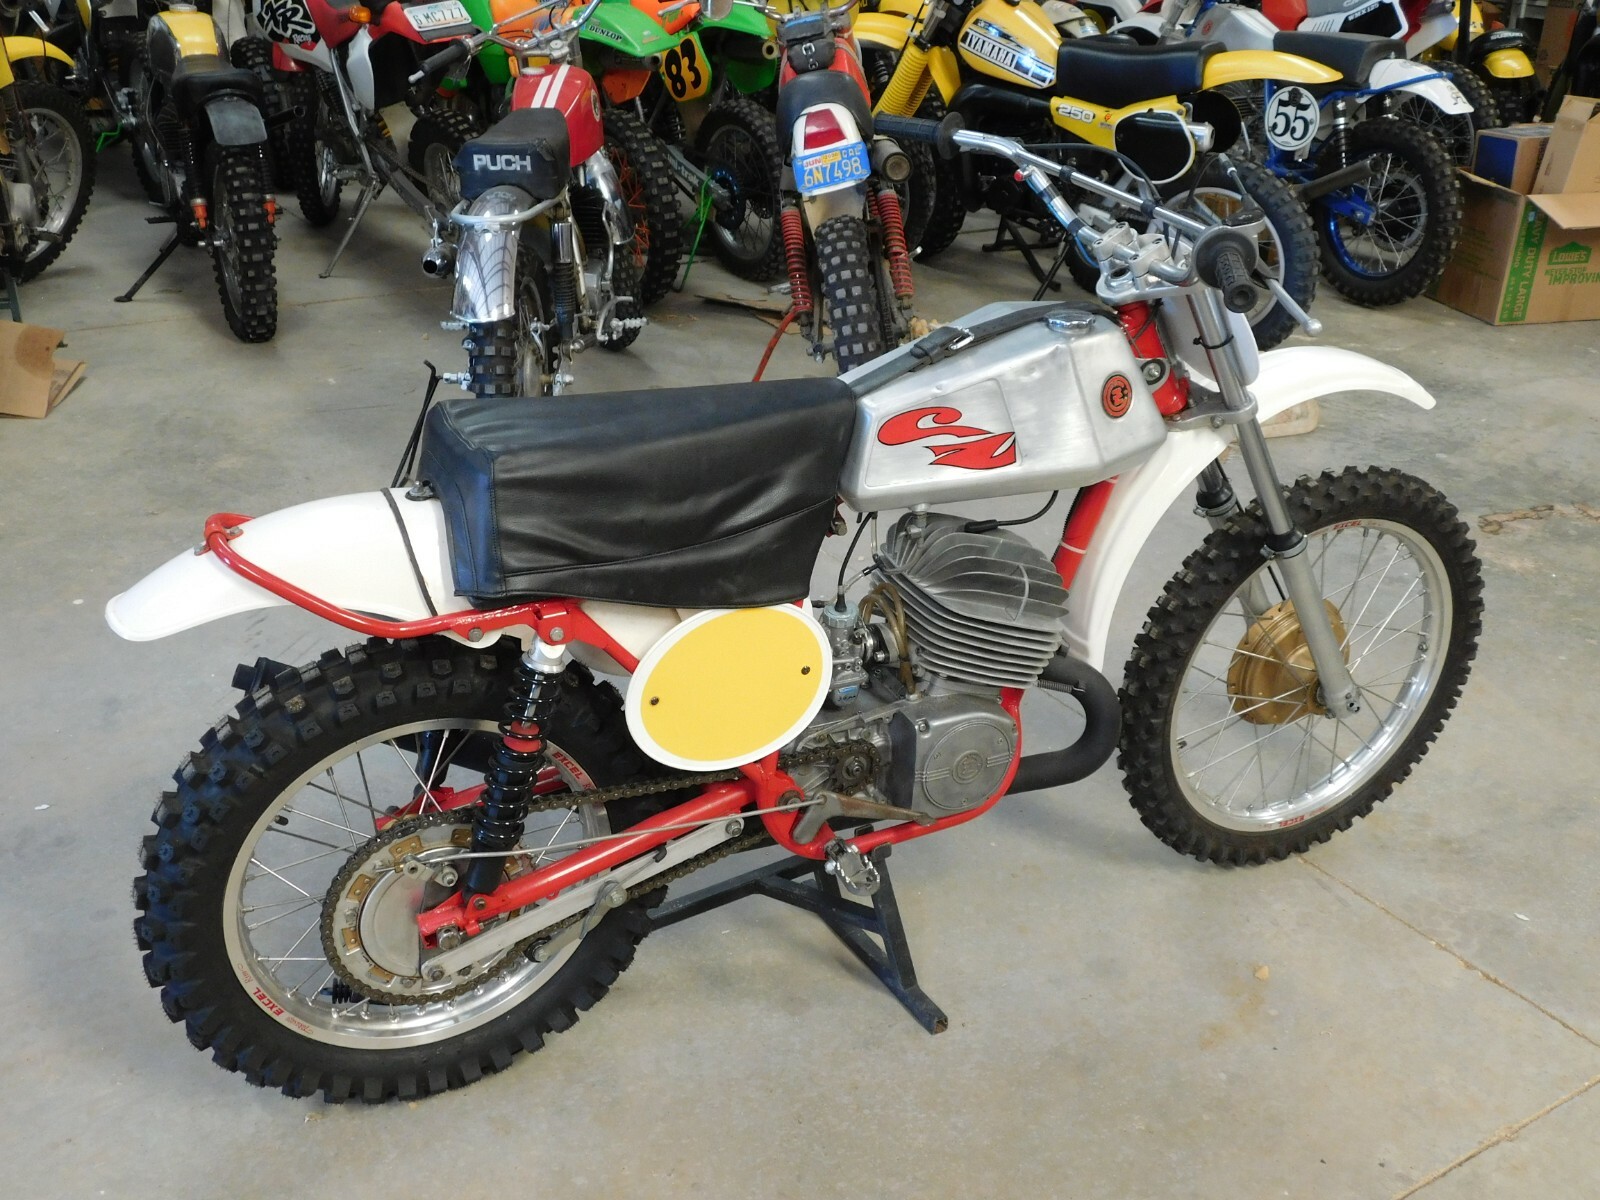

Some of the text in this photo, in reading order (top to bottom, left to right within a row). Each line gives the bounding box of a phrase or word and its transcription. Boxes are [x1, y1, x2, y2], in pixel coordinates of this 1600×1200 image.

[589, 25, 622, 41] DUNLOP
[1490, 30, 1523, 40] SUZUKI
[968, 32, 1013, 68] YAMAHA
[665, 38, 702, 98] 83
[1057, 103, 1094, 123] 250
[1272, 99, 1311, 141] 55
[472, 154, 532, 172] PUCH
[803, 157, 863, 187] 6N7498
[1521, 247, 1536, 277] DUTY
[1511, 280, 1529, 318] LARGE
[552, 751, 583, 780] EXCEL
[252, 986, 285, 1017] EXCEL
